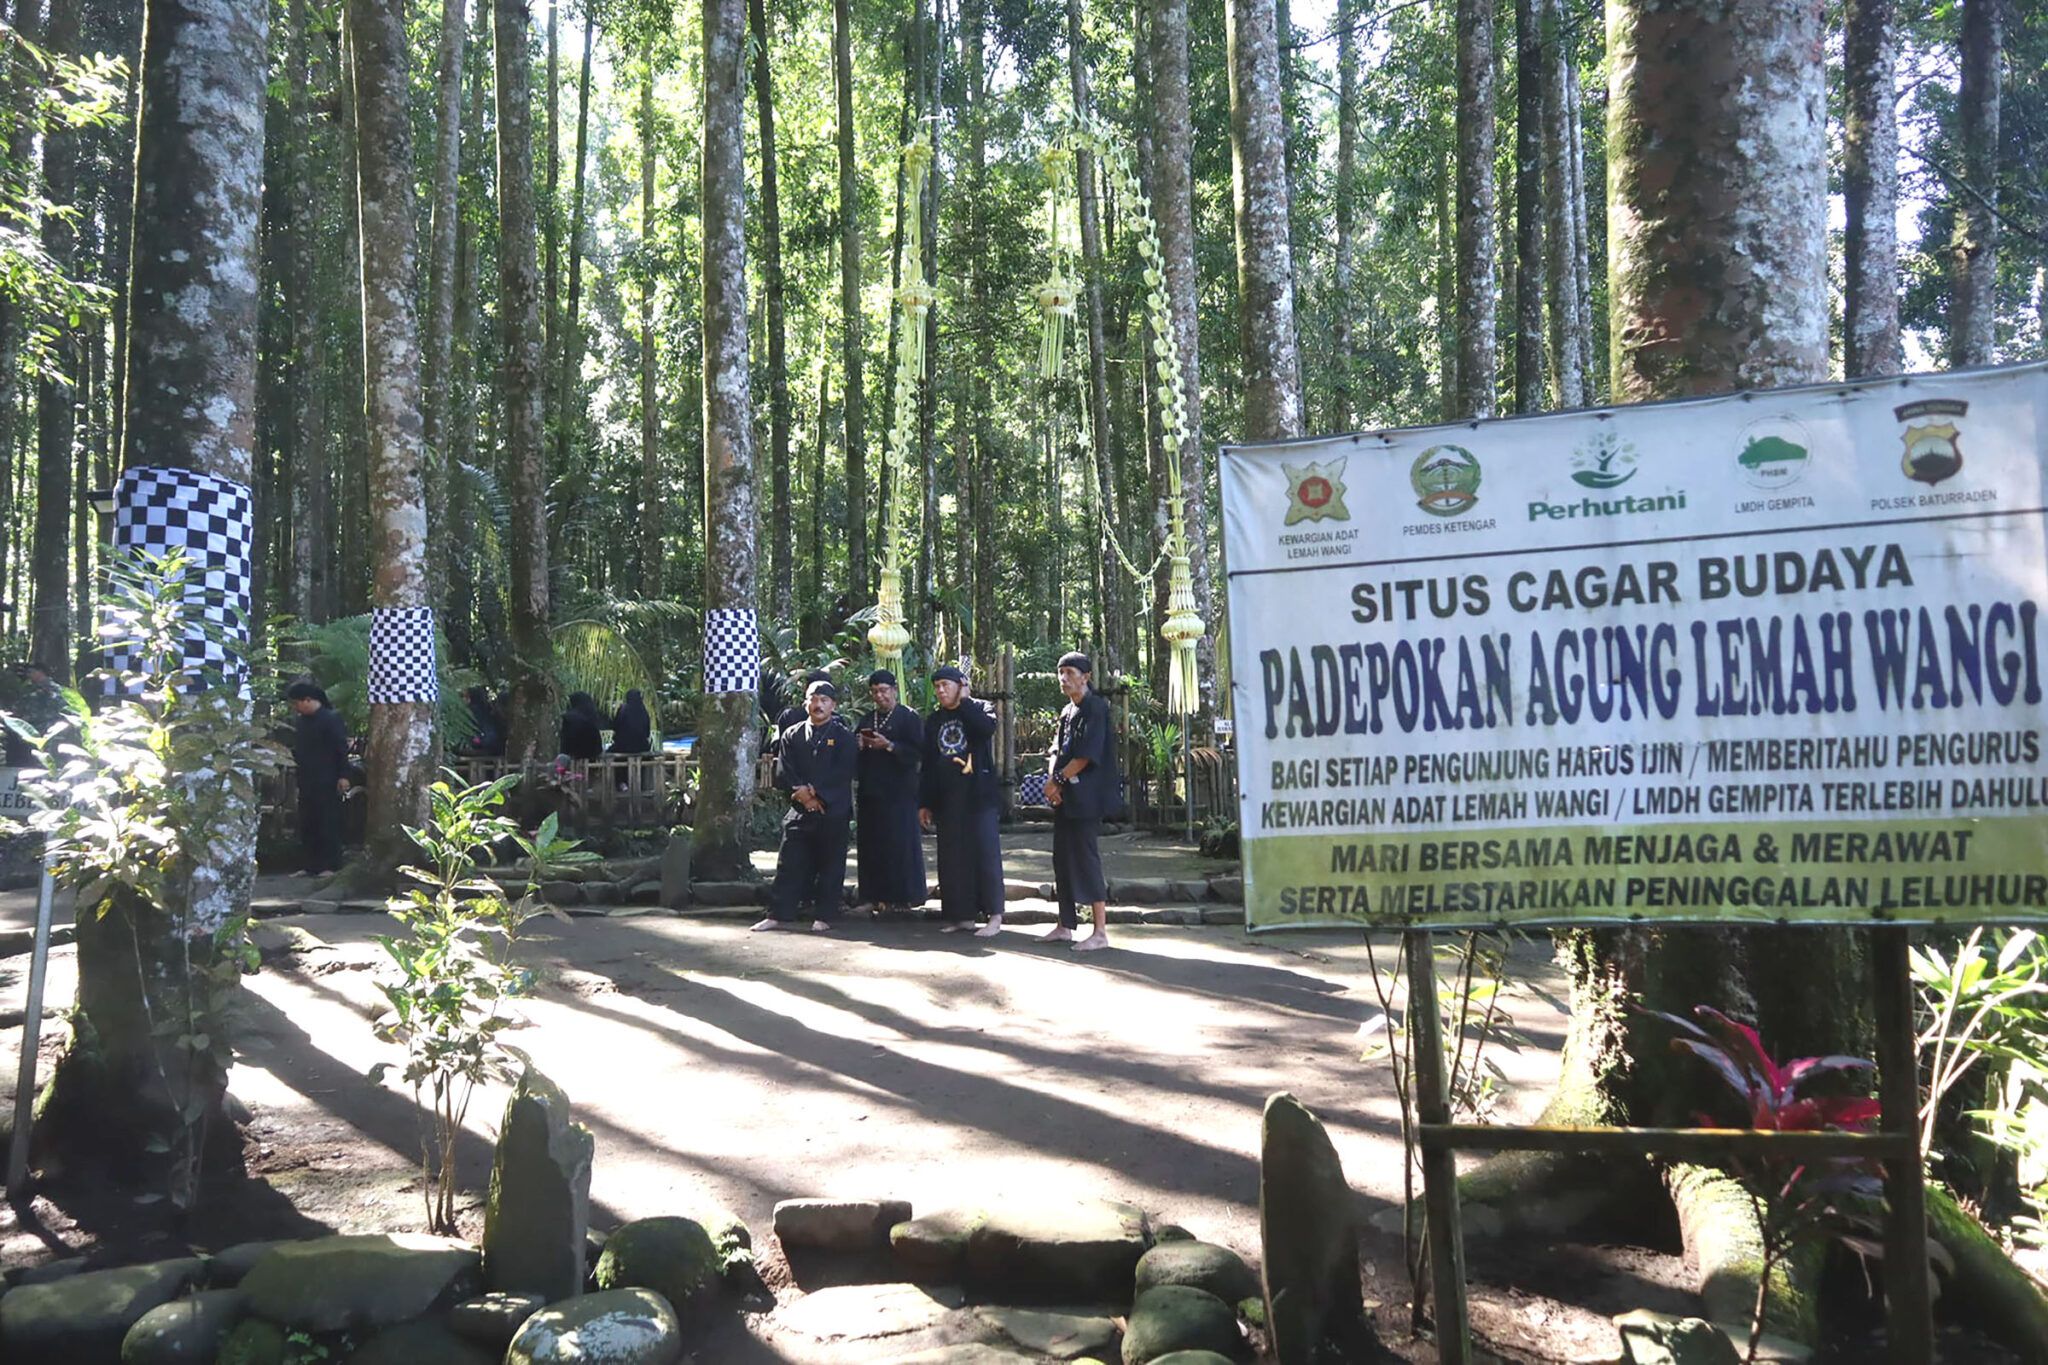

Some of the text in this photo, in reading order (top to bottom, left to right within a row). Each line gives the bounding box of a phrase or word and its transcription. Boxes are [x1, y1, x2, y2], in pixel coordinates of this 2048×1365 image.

[1528, 491, 1686, 521] Perhutani
[1734, 496, 1815, 514] LMDH GEMPITA
[1871, 494, 1916, 510] POLSEK
[1279, 529, 1359, 546] KEWARGIAN ADAT
[1403, 519, 1496, 536] PEMDES KETENGAR
[1288, 545, 1352, 559] LEMAH WANGI
[1351, 544, 1914, 623] SITUS CAGAR BUDAYA
[1260, 600, 2042, 739] PADEPOKAN AGUNG LEMAH WANGI
[1272, 759, 1319, 790] BAGI
[1326, 755, 1398, 787] SETIAP
[1404, 748, 1550, 784] PENGUNJUNG
[1557, 744, 1634, 777] HARUS
[1689, 741, 1700, 780] /
[1708, 735, 1889, 773] MEMBERITAHU
[1897, 730, 2040, 767] PENGURUS
[1262, 797, 1386, 829] KEWARGIAN
[1392, 794, 1446, 824] ADAT
[1452, 791, 1527, 822] LEMAH
[1534, 788, 1609, 818] WANGI
[1614, 788, 1625, 821] /
[1633, 786, 1700, 815] LMDH
[1708, 783, 1814, 814] GEMPITA
[1822, 780, 1942, 811] TERLEBIH
[1331, 830, 1973, 873] MARI BERSAMA MENJAGA & MERAWAT
[1279, 874, 2048, 915] SERTA MELESTARIKAN PENINGGALAN LELUHUR
